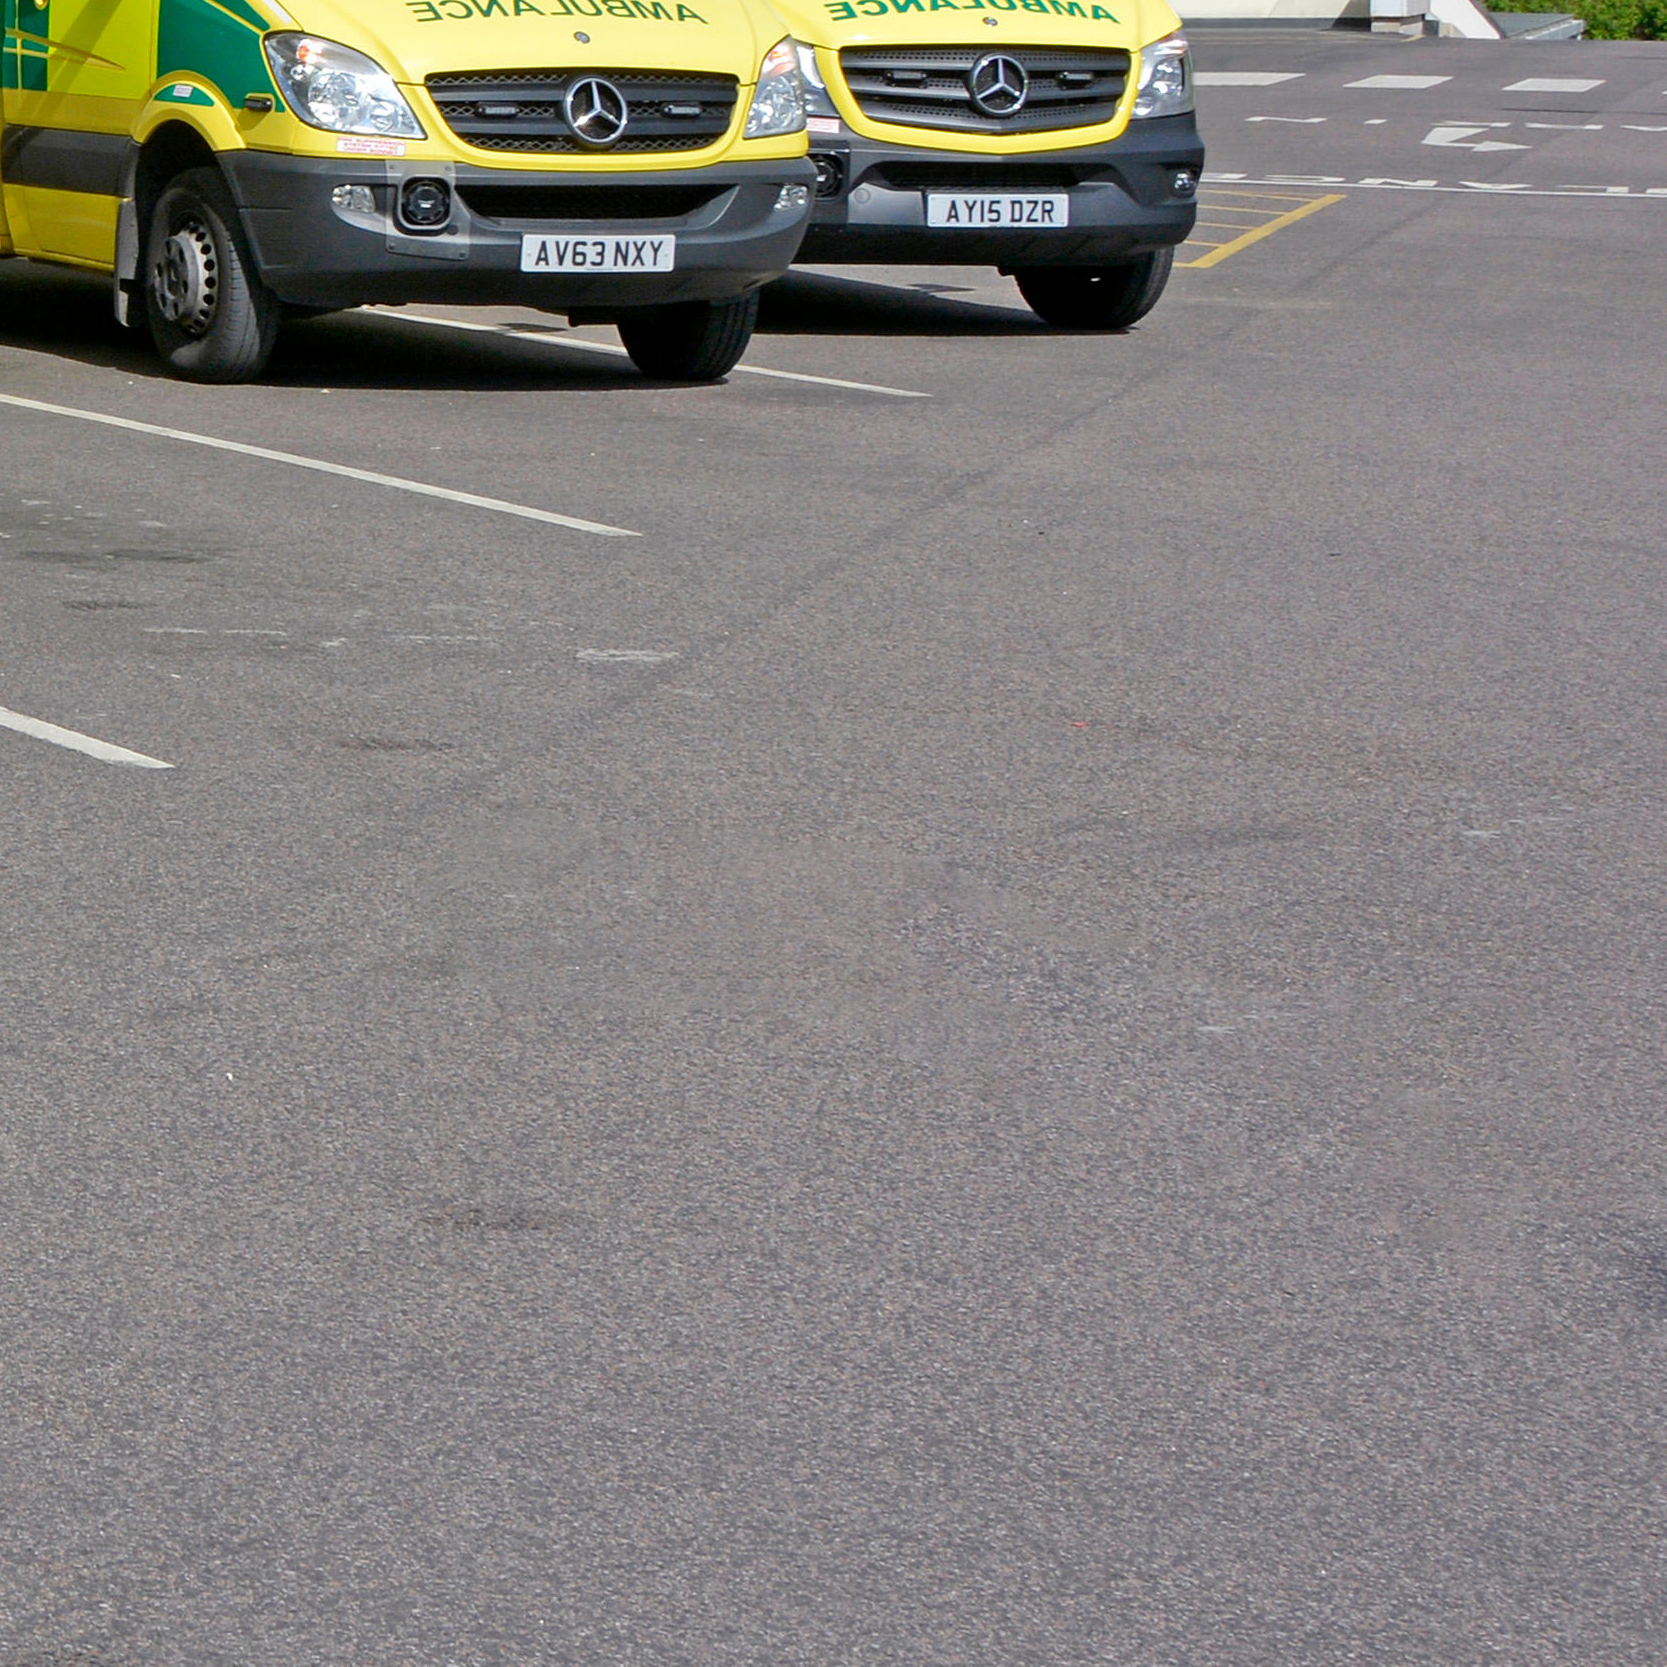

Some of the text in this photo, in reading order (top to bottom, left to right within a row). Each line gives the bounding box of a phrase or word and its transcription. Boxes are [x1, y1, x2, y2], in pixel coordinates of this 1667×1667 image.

[945, 199, 1055, 223] AY15 DZR
[534, 240, 664, 267] AV63 NXY
